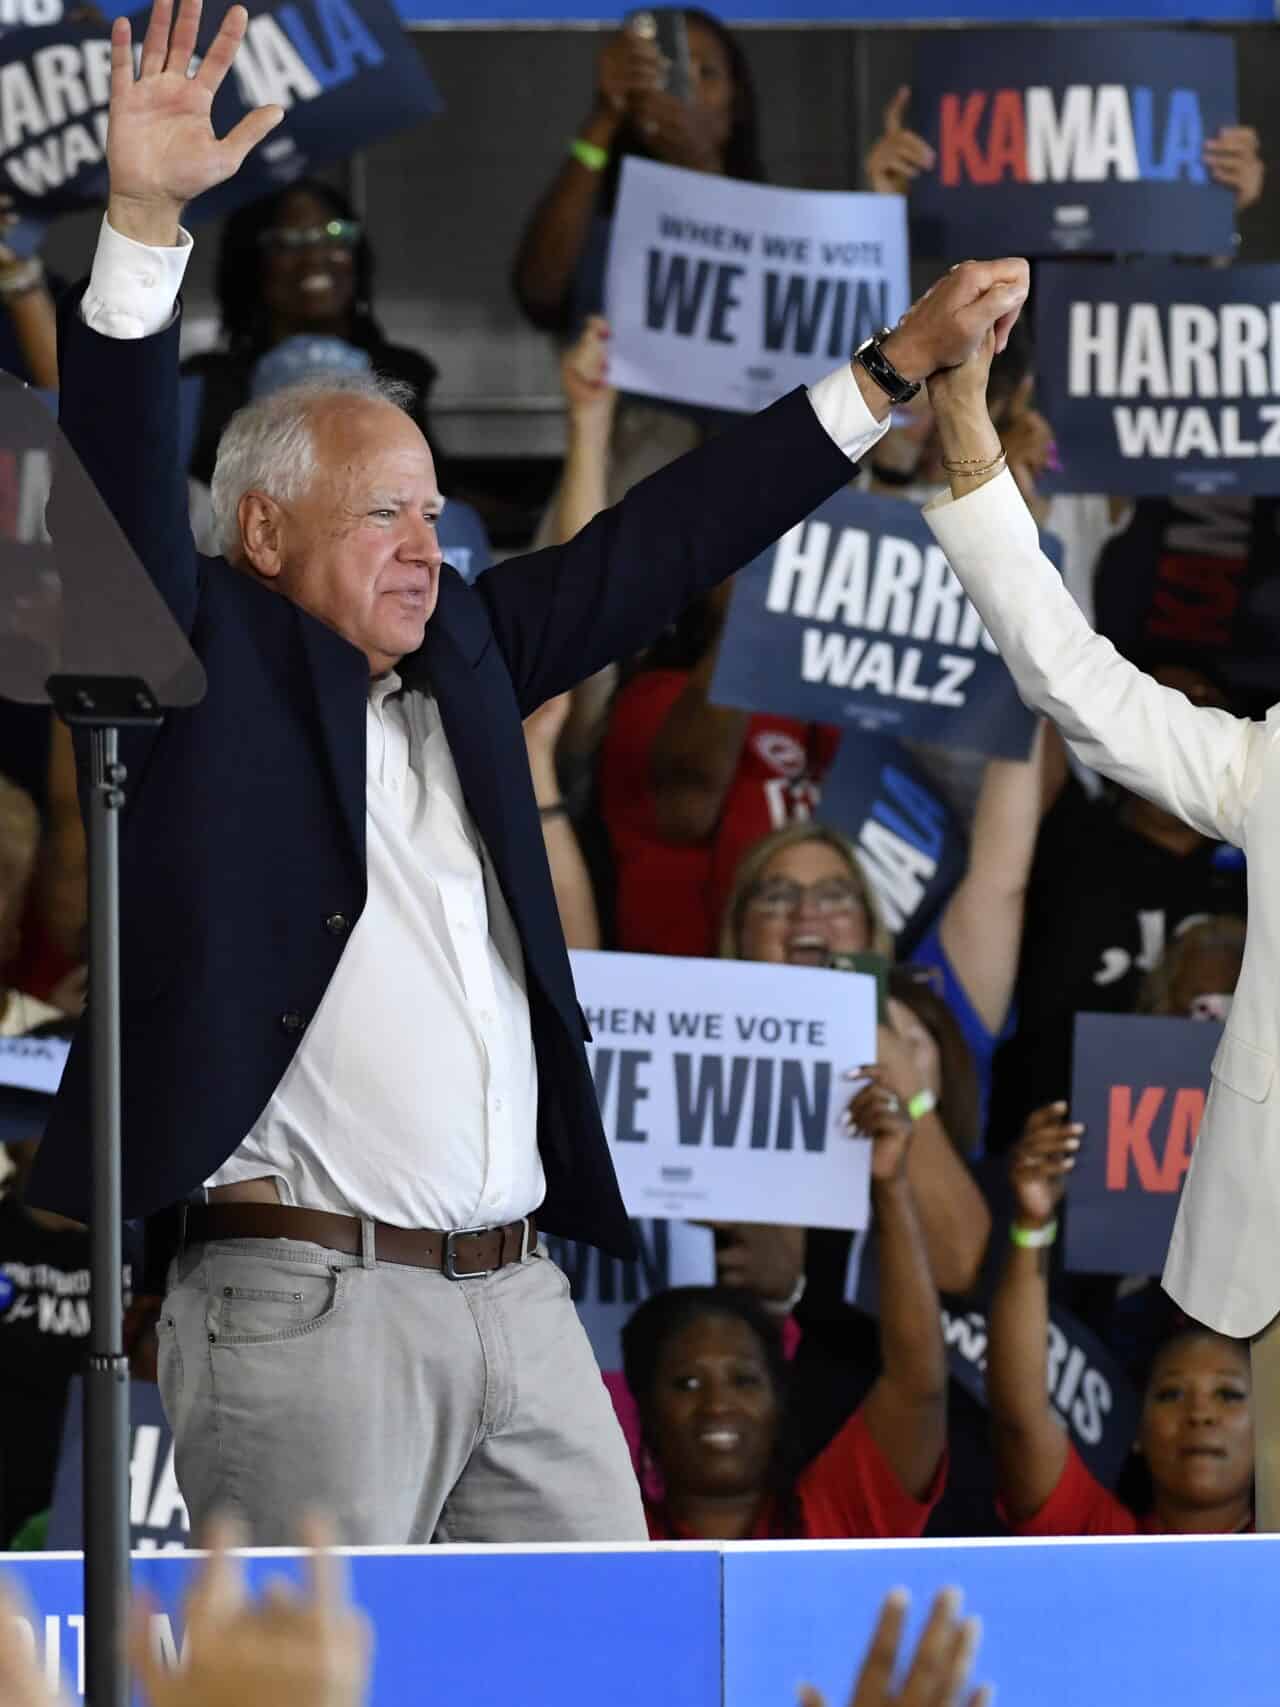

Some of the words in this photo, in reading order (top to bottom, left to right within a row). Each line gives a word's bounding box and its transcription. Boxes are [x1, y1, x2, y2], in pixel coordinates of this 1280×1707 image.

[233, 0, 385, 108] ALA
[4, 112, 108, 196] WA
[938, 85, 1209, 188] KAMALA
[659, 213, 754, 254] WHEN
[762, 232, 812, 264] WE
[819, 239, 884, 267] VOTE
[644, 249, 751, 345] WE
[761, 271, 890, 361] WIN
[765, 519, 1000, 655] HARR
[801, 628, 976, 708] WALZ
[584, 1006, 656, 1036] HEN
[668, 1011, 723, 1040] WE
[735, 1016, 826, 1046] VOTE
[673, 1052, 833, 1153] WIN
